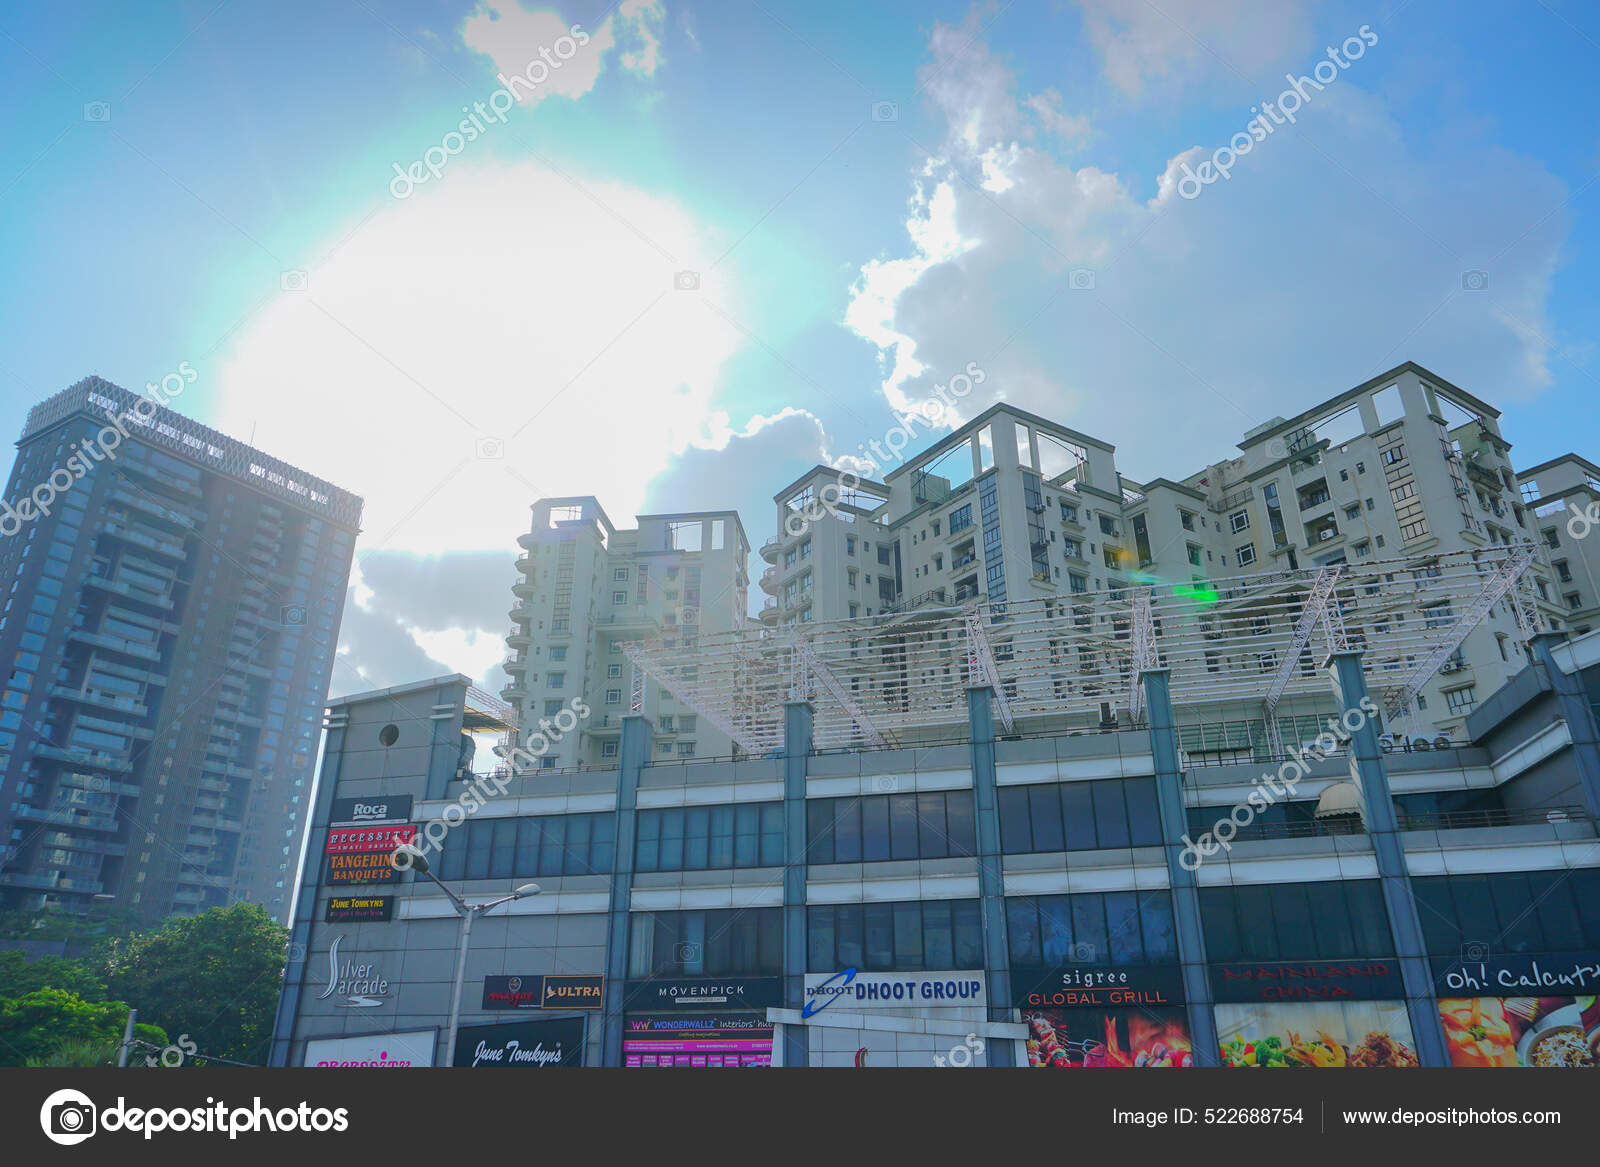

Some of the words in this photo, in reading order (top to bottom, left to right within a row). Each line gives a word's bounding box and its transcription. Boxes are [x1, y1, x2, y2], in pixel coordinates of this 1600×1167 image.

[353, 803, 388, 815] Roca
[333, 868, 392, 881] BANQUETS
[1063, 970, 1128, 987] sigree
[1223, 963, 1389, 980] MAINLAND
[338, 975, 389, 995] arcade
[557, 986, 601, 997] ULTRA
[855, 982, 916, 1000] DHOOT
[920, 981, 981, 999] GROUP
[1261, 984, 1354, 1000] CHINA
[1028, 992, 1102, 1006] GLOBAL
[1109, 991, 1168, 1003] GRILL
[472, 1039, 504, 1067] June
